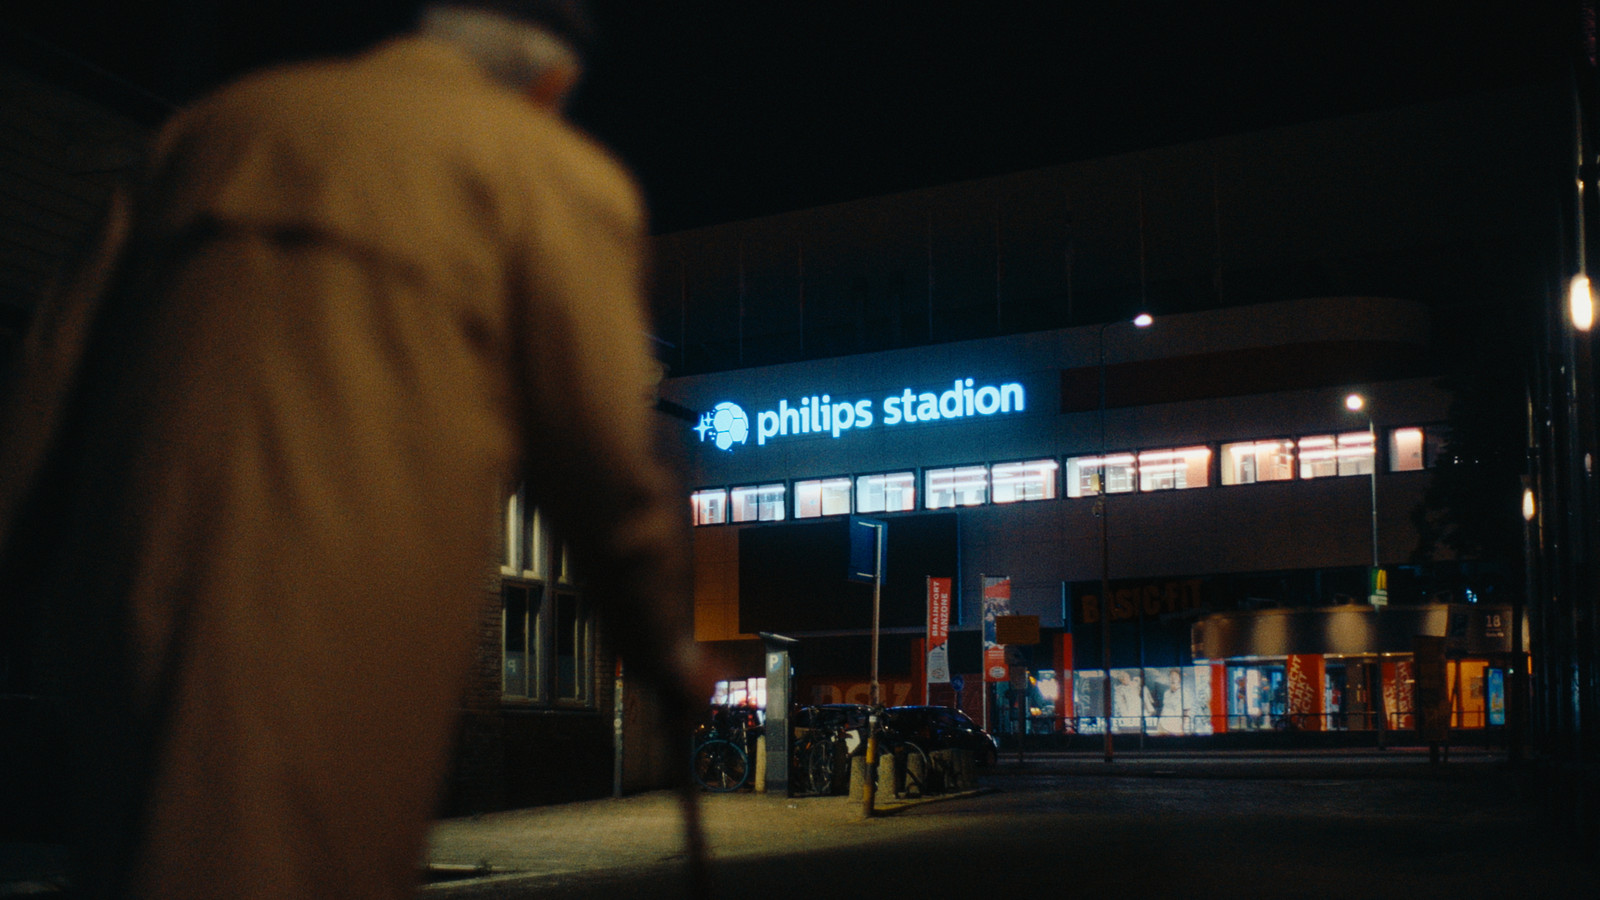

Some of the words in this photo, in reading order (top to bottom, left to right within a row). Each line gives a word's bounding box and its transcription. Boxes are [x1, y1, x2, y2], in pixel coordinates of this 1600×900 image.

[757, 394, 873, 445] philips
[883, 377, 1025, 425] stadion
[932, 580, 940, 637] BRAINPORT
[940, 592, 949, 637] FANZONE
[1485, 614, 1501, 628] 18
[769, 654, 779, 669] P
